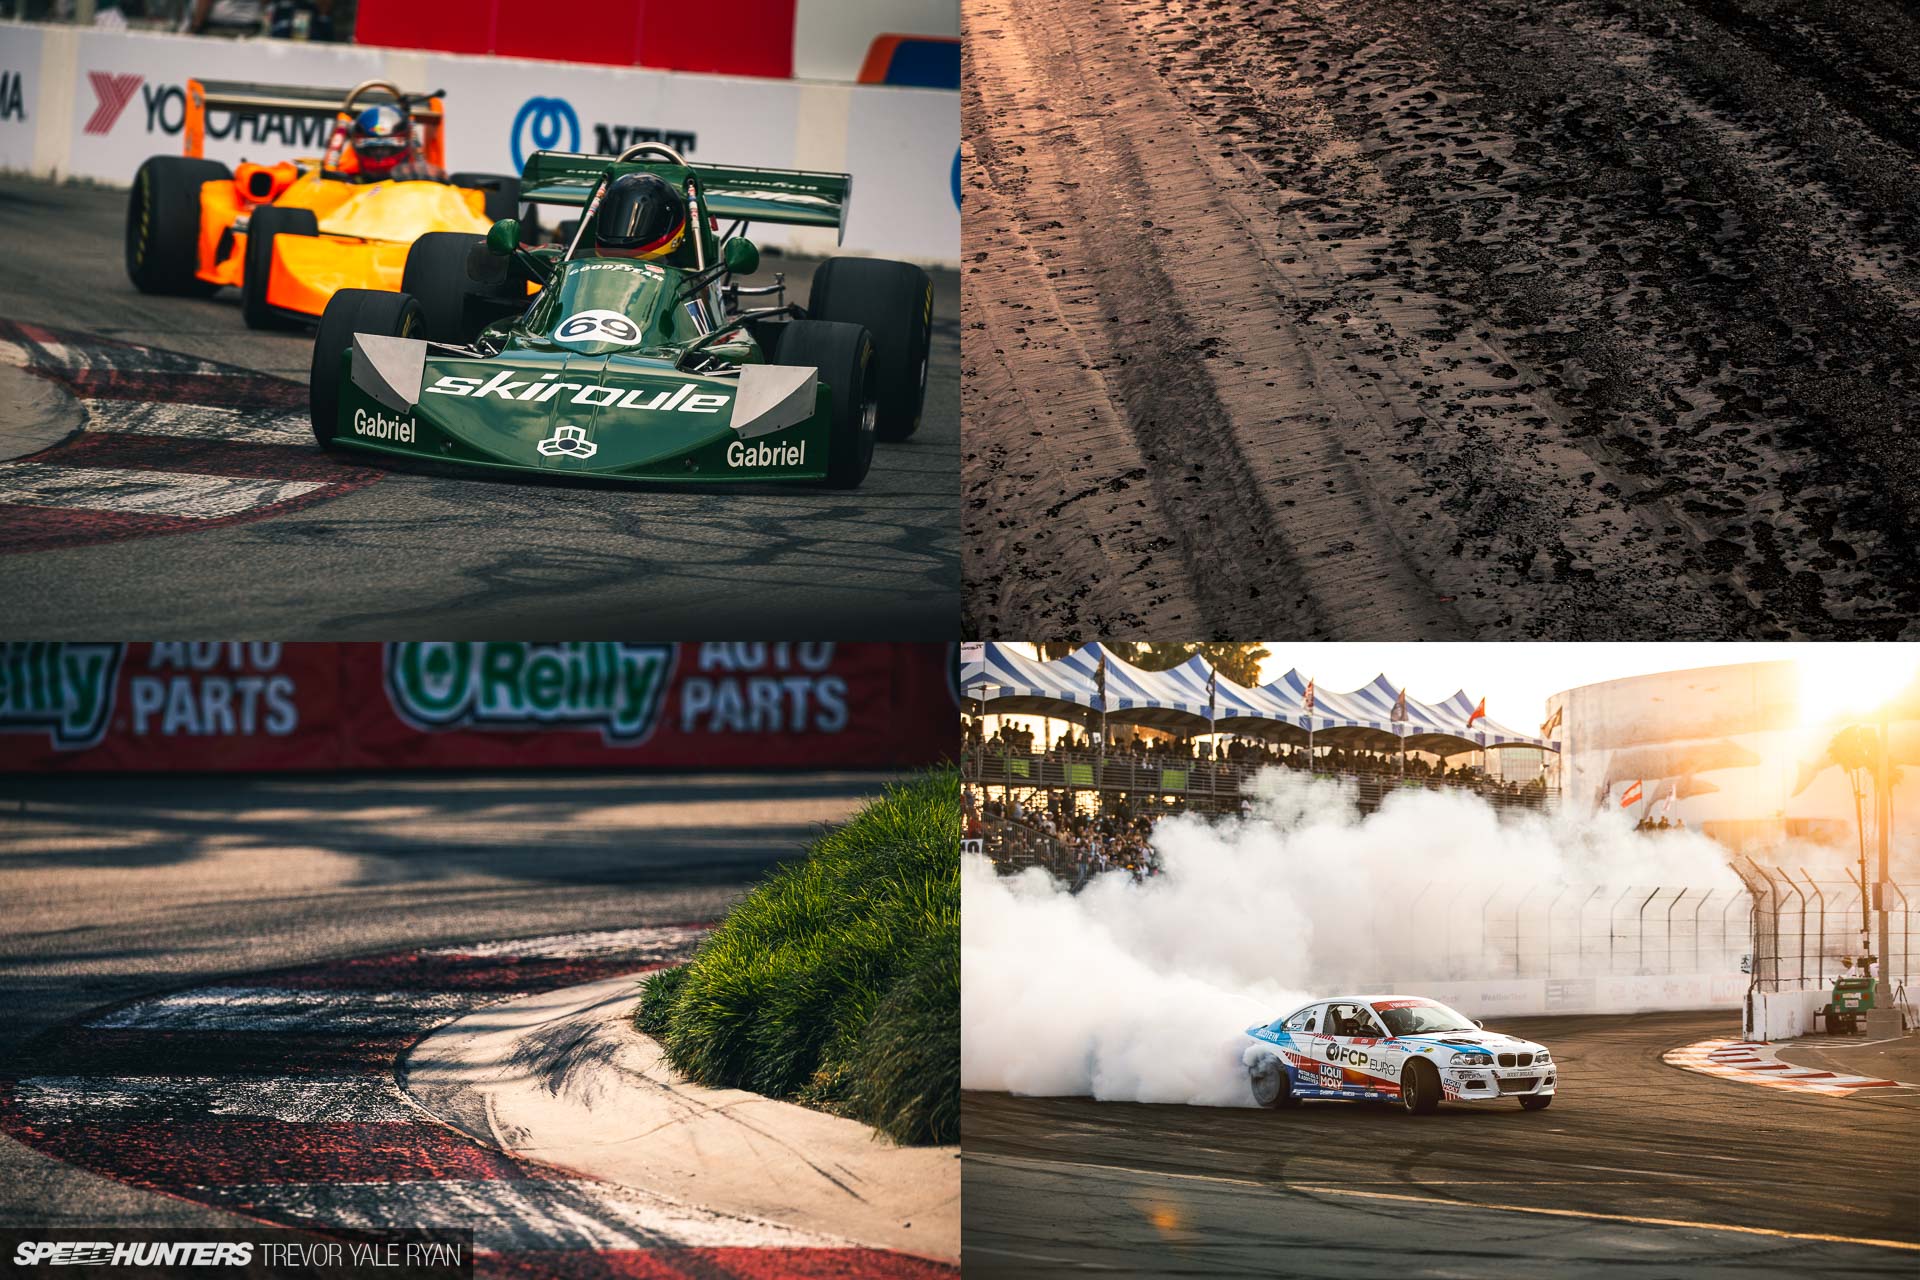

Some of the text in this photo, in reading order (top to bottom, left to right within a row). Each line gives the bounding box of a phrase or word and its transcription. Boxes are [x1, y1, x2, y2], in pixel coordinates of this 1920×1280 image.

[143, 85, 335, 149] YOOHAM
[594, 122, 697, 156] NTT
[568, 263, 665, 281] GOODYEAR
[560, 315, 637, 341] 69
[425, 371, 736, 414] skiroule
[354, 408, 416, 444] Gabriel
[726, 438, 806, 468] Gabriel
[130, 676, 299, 736] PARTS
[680, 675, 850, 734] PARTS
[1320, 1064, 1343, 1080] LIQUI
[1340, 1046, 1396, 1076] FCP EURO
[1320, 1076, 1343, 1089] MOLY
[1443, 1085, 1460, 1094] MOLY
